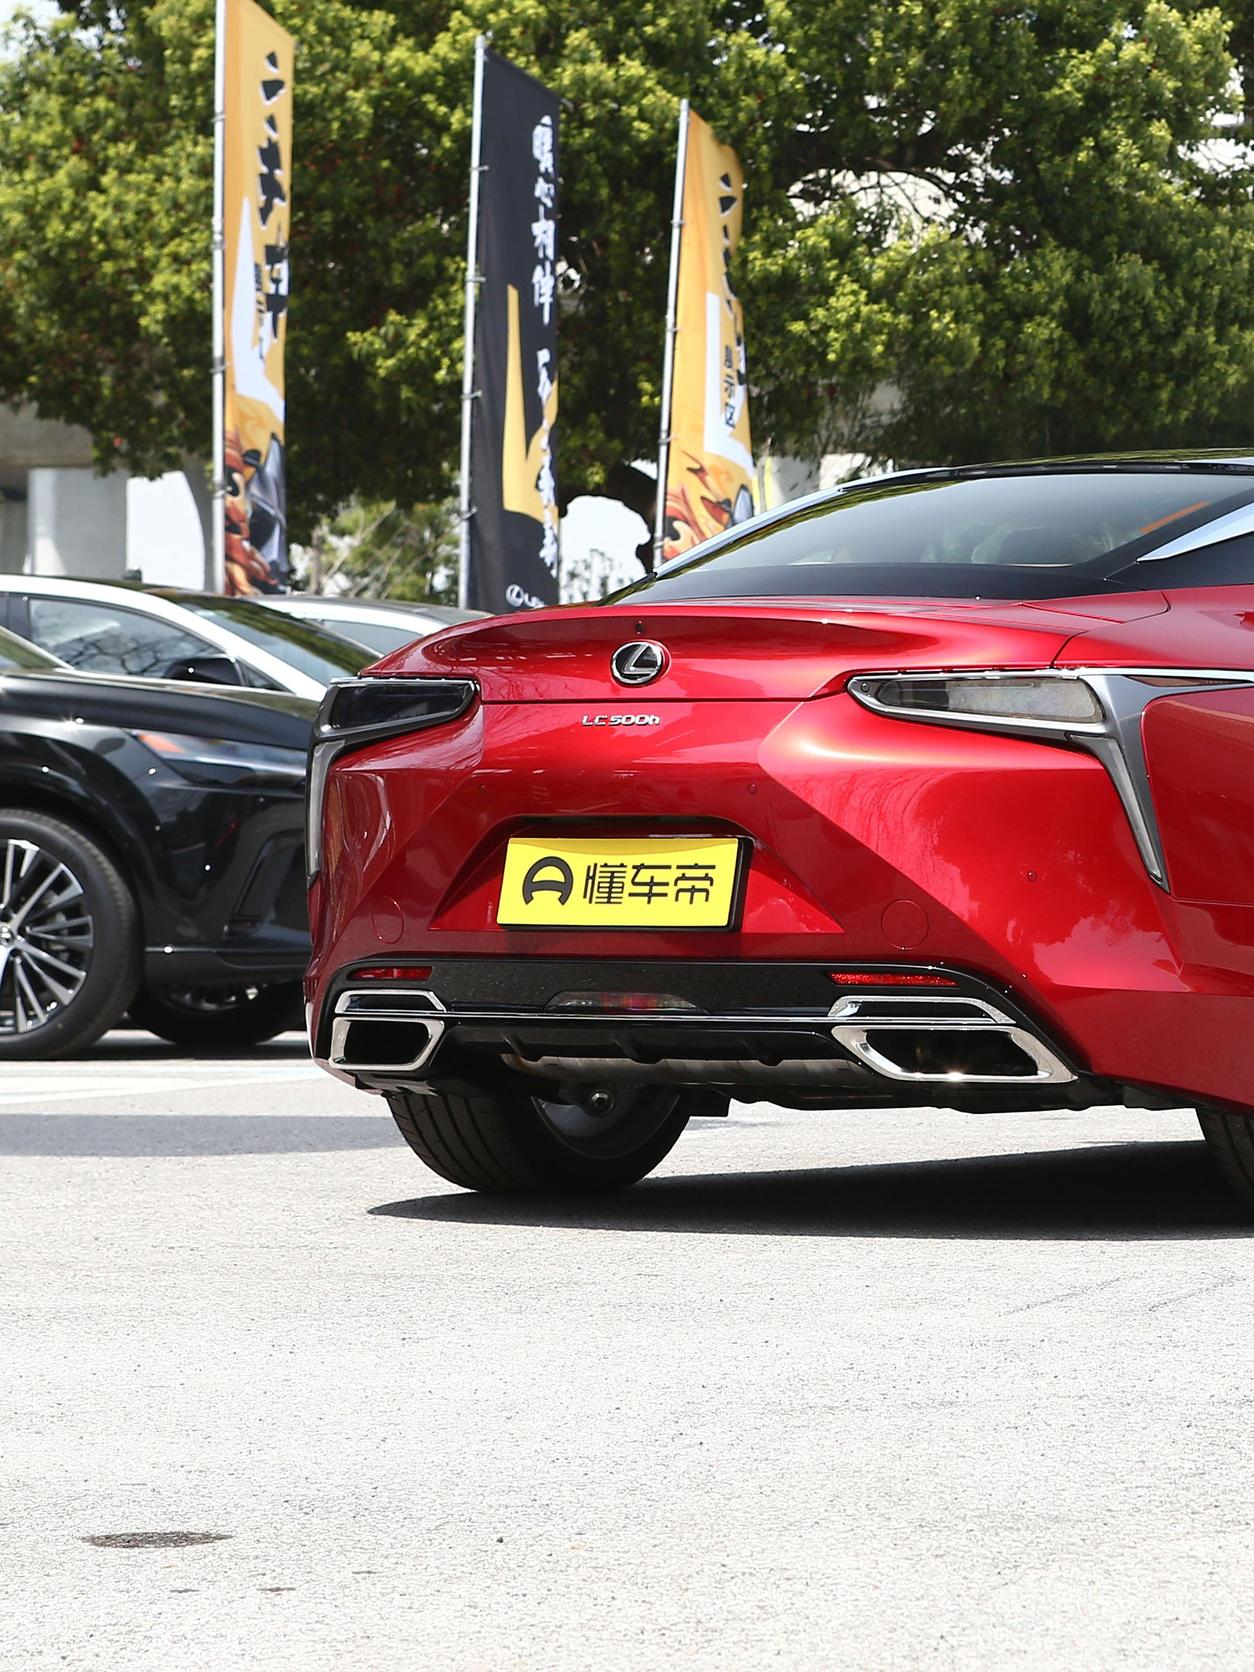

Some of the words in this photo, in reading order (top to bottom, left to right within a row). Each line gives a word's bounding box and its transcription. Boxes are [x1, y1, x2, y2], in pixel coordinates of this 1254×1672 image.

[581, 714, 607, 727] LC
[608, 714, 661, 727] 500h
[583, 861, 717, 905] 懂车帝
